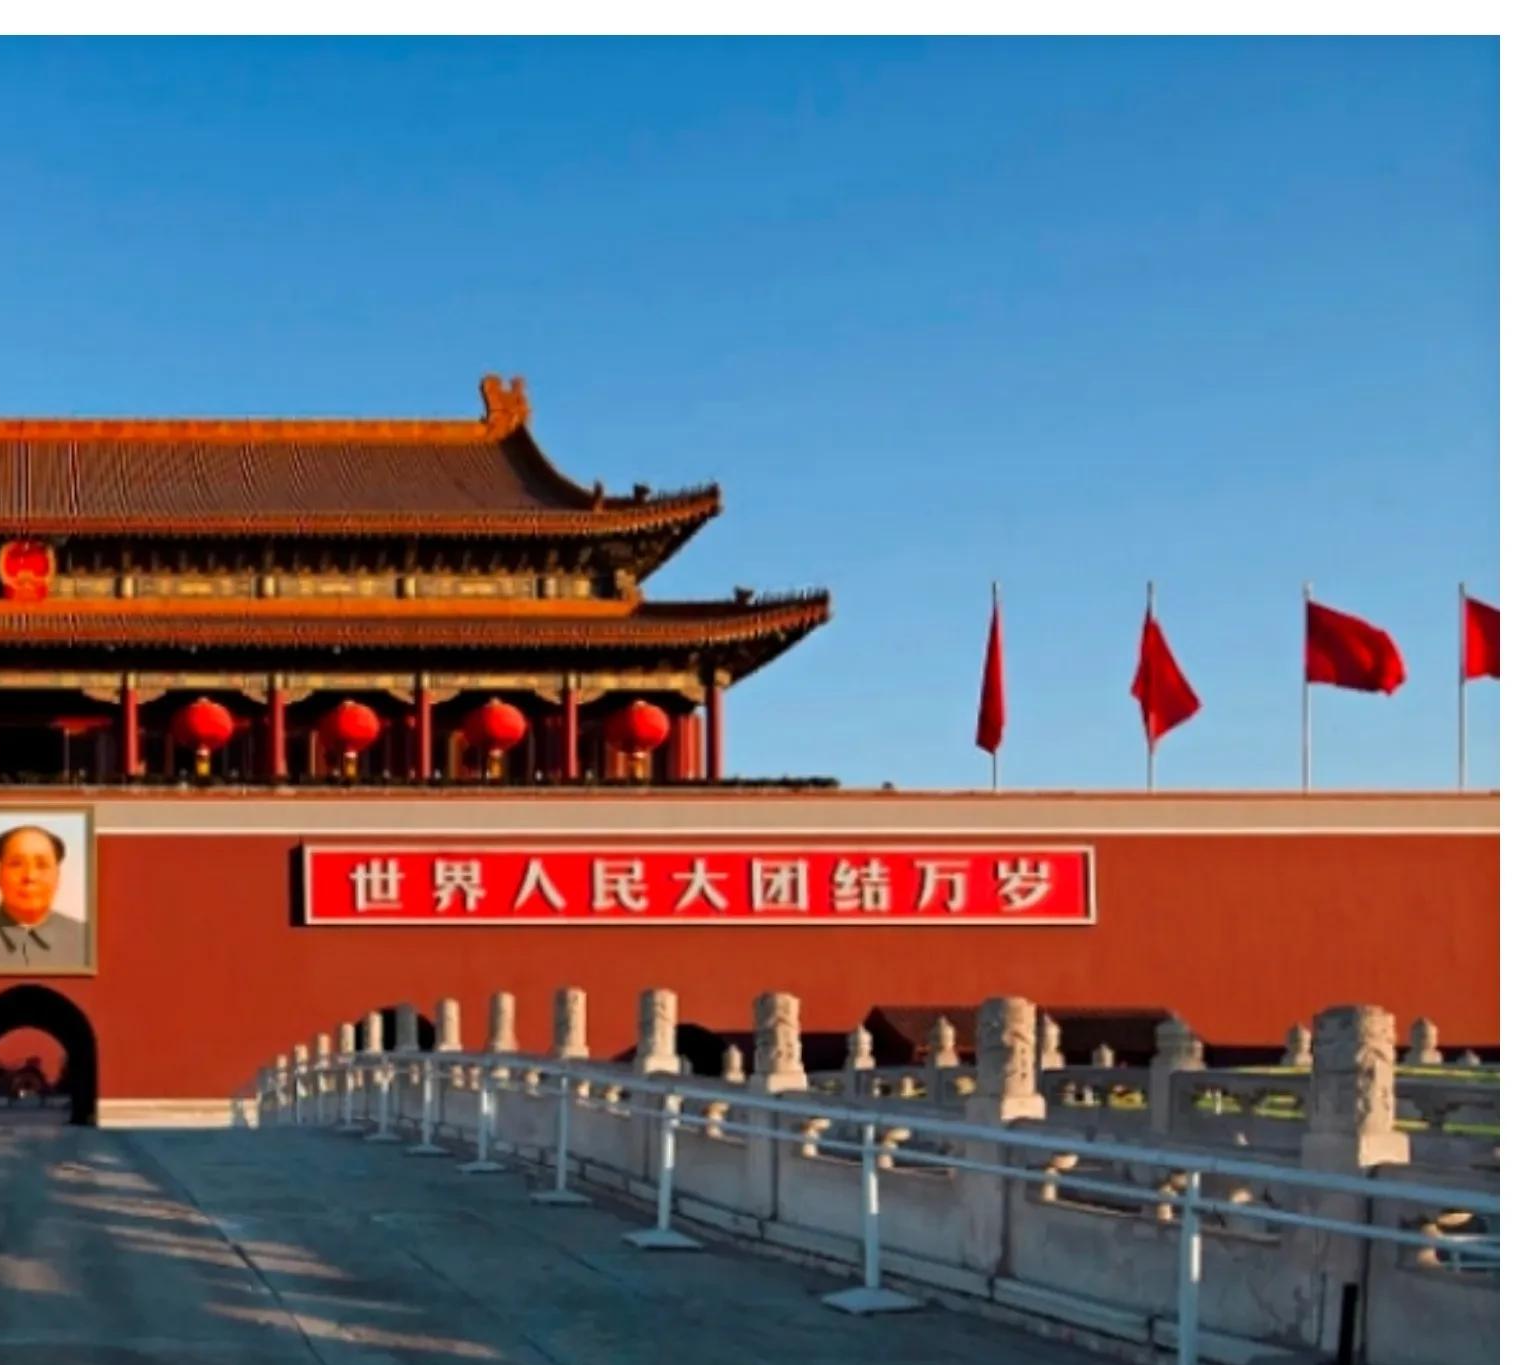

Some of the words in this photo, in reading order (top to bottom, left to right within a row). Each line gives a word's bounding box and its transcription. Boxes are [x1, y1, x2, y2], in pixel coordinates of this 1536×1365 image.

[349, 858, 1053, 912] 世界人民大团结万岁
